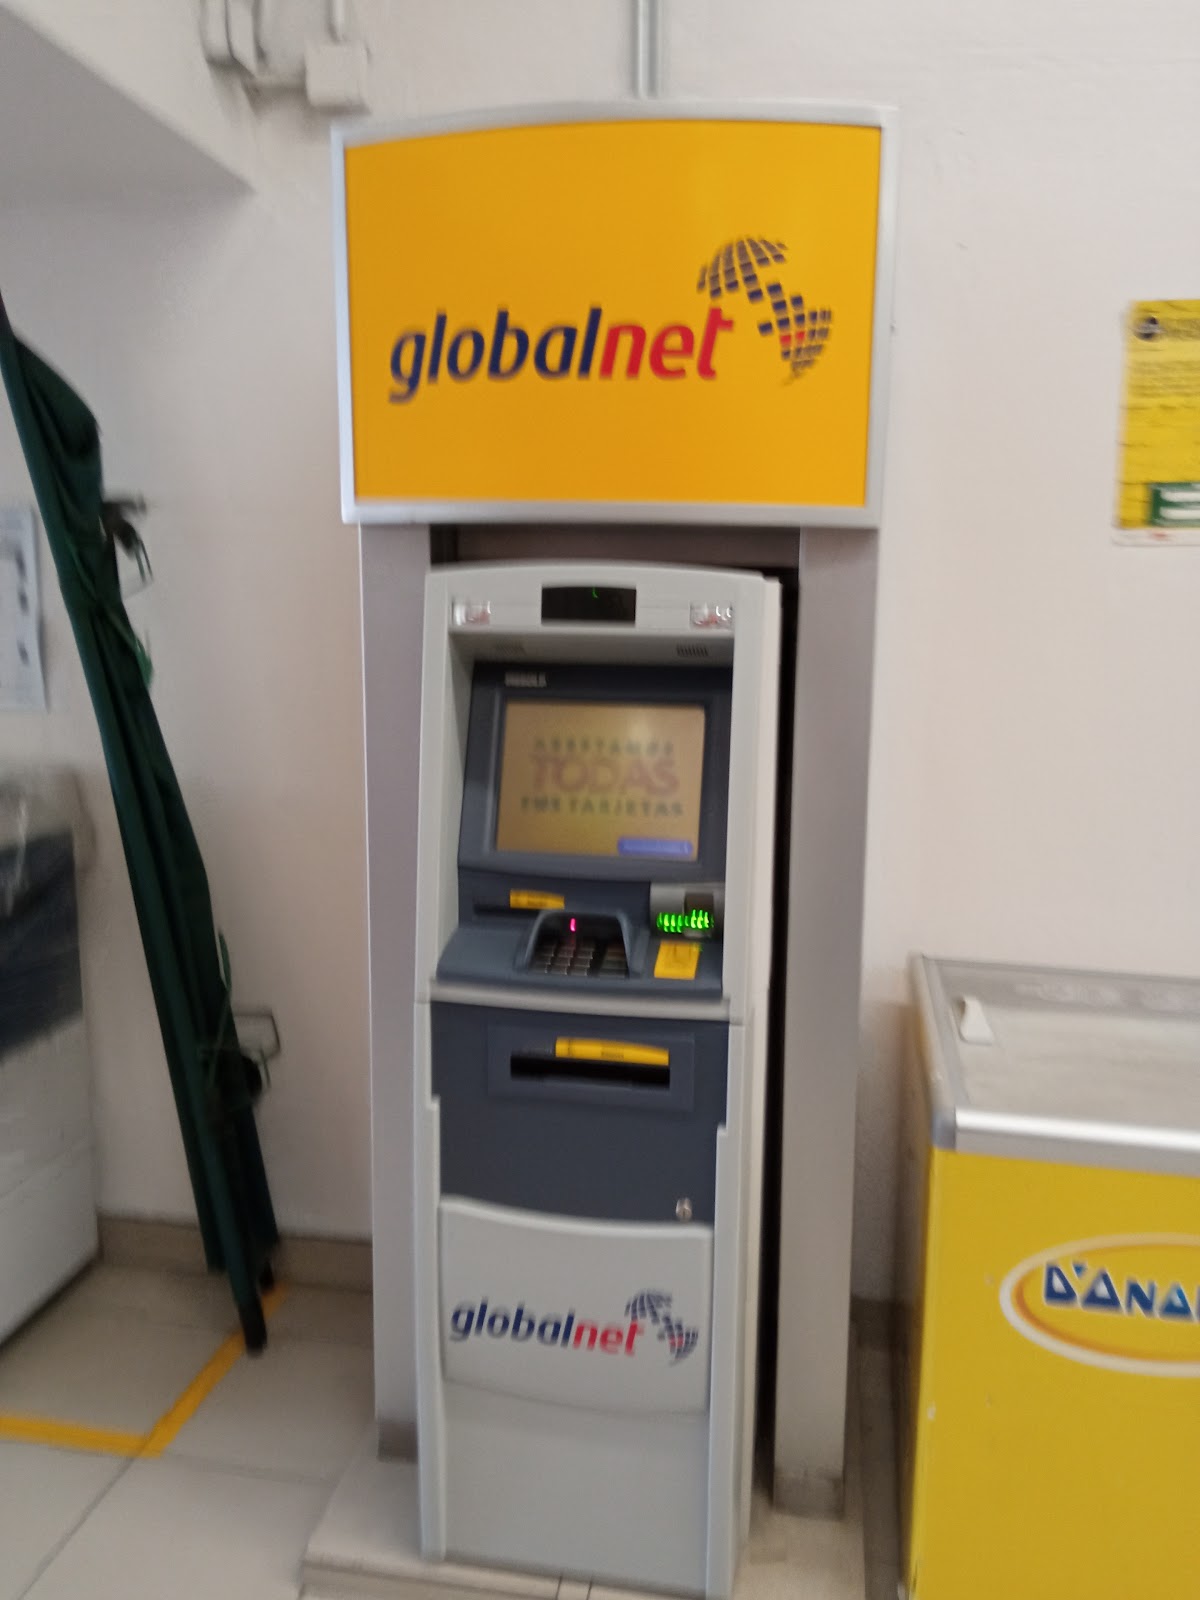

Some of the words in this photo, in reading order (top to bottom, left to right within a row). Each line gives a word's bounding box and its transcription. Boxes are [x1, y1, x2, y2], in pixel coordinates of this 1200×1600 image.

[388, 304, 733, 404] globalnet
[529, 754, 680, 796] TODAS
[1043, 1262, 1200, 1323] D'ANA
[449, 1298, 644, 1356] globalnet
